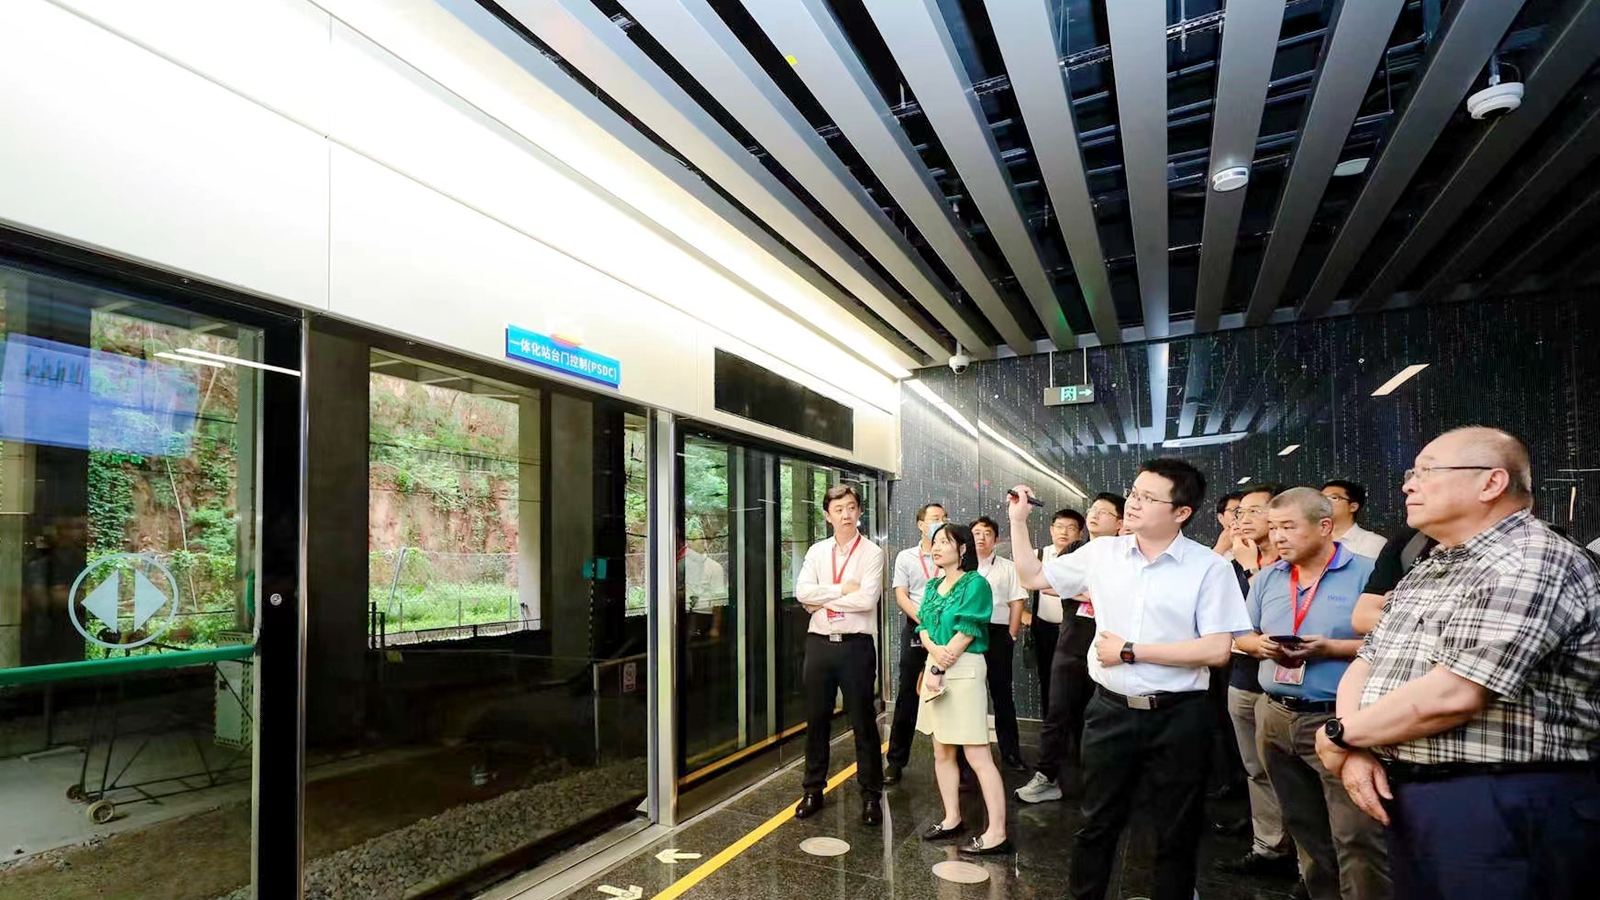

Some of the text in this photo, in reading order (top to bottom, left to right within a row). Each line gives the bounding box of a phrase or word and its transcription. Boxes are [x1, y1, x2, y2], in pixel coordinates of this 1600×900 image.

[508, 338, 617, 380] 一体化站台门控制(PSDC)
